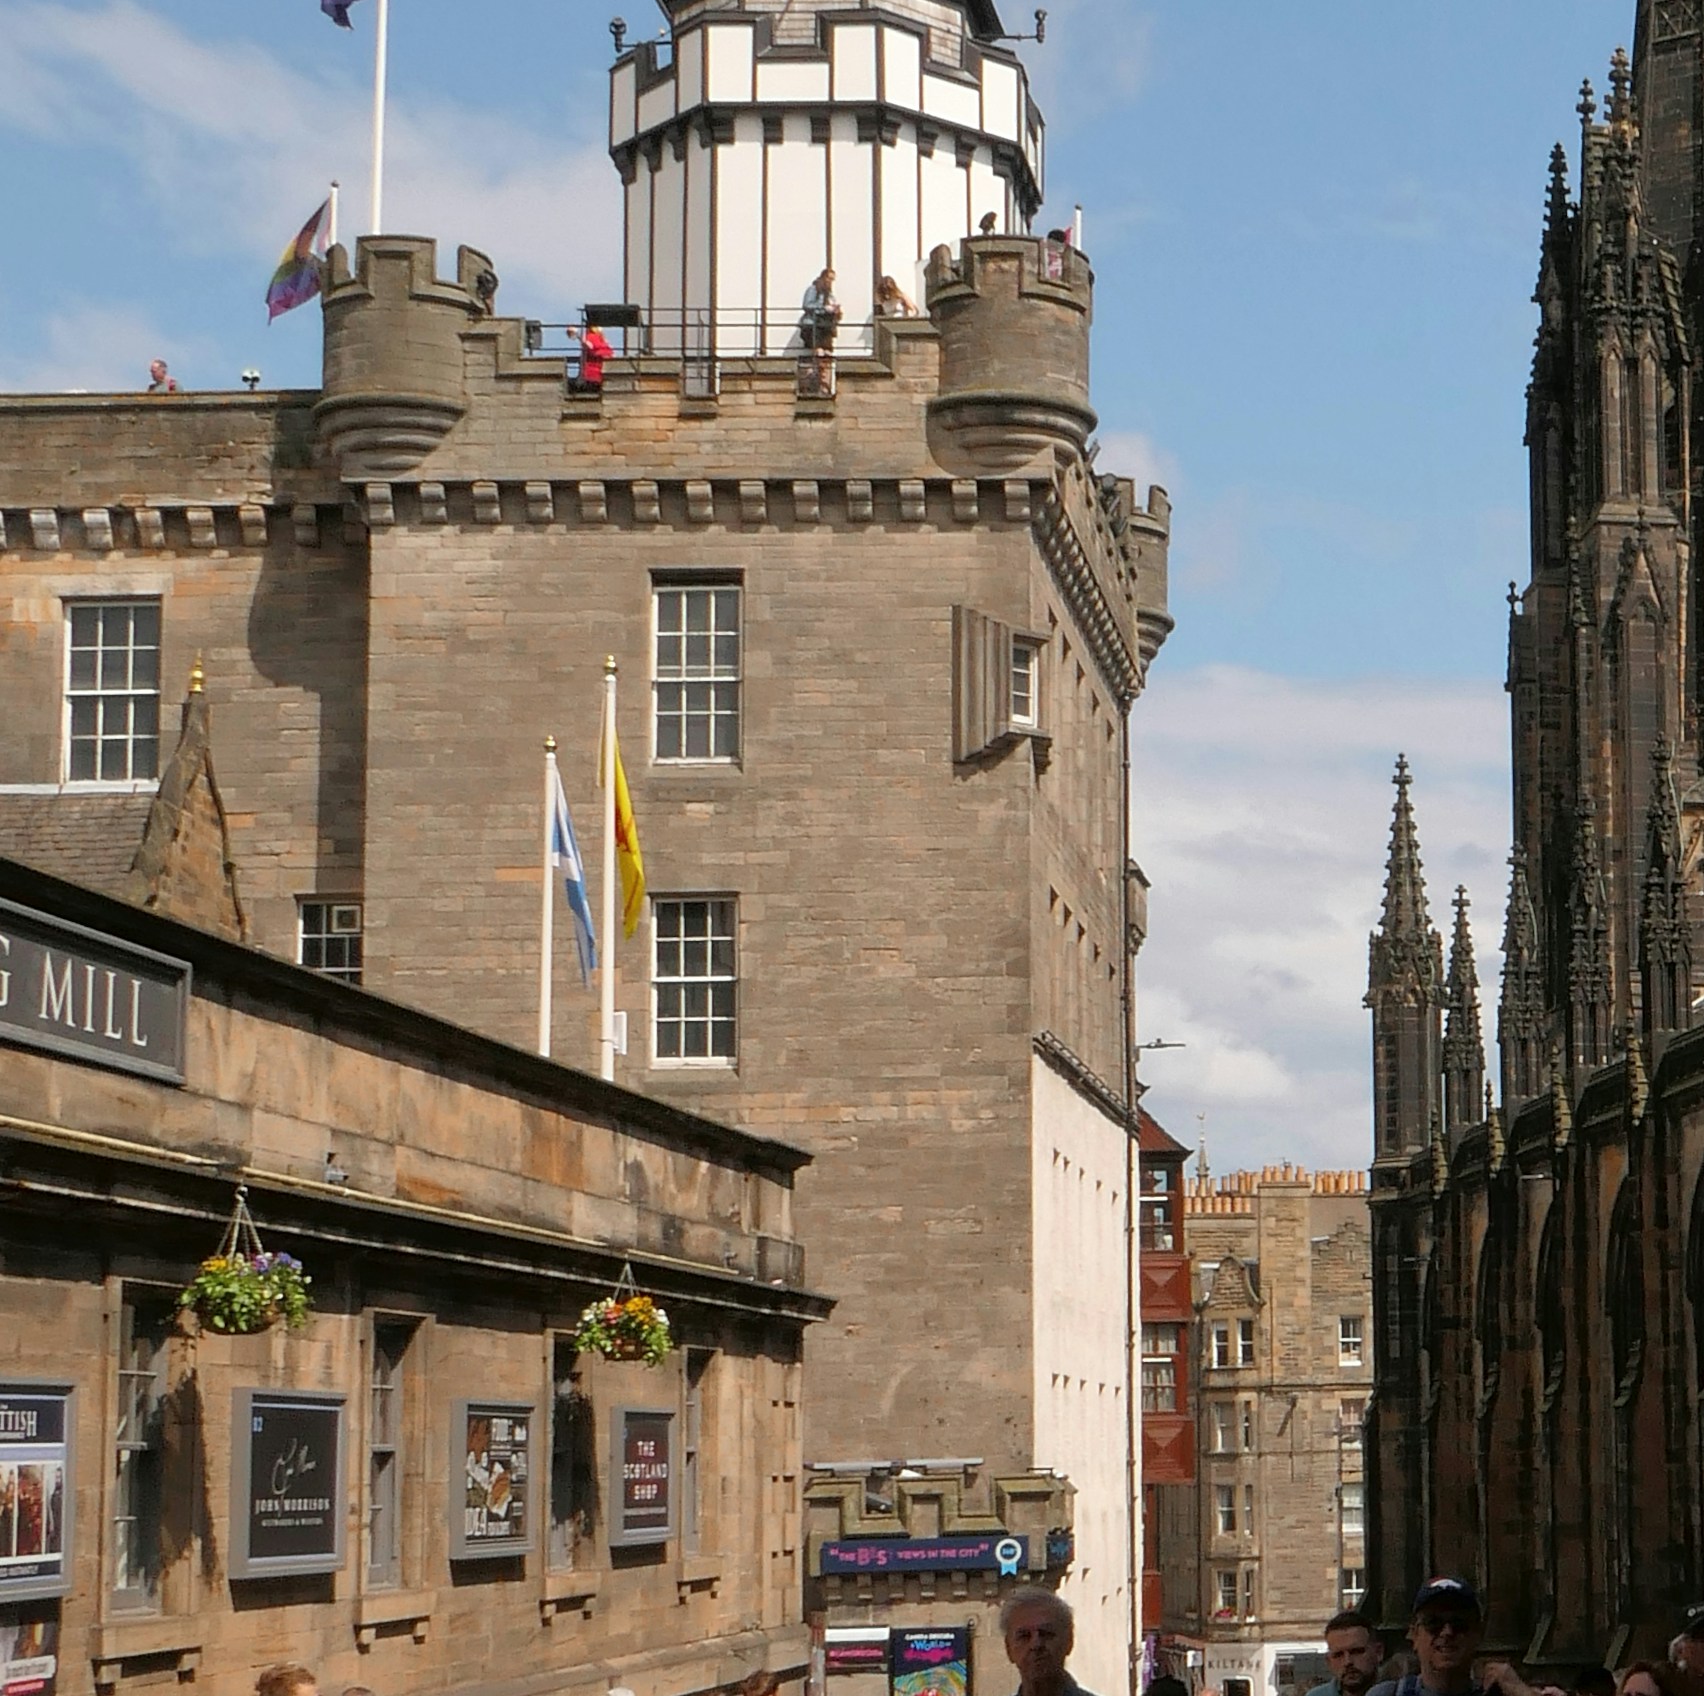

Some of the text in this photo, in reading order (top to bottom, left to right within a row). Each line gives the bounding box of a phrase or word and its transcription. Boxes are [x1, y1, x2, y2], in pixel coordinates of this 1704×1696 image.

[39, 951, 149, 1047] MILL
[636, 1441, 655, 1457] THE
[623, 1463, 668, 1479] SCOTLAND
[633, 1484, 658, 1500] SHOP
[254, 1497, 331, 1515] JOHN MORRISON
[897, 1548, 927, 1559] VIEWS
[928, 1548, 939, 1559] IN
[940, 1547, 957, 1558] THE
